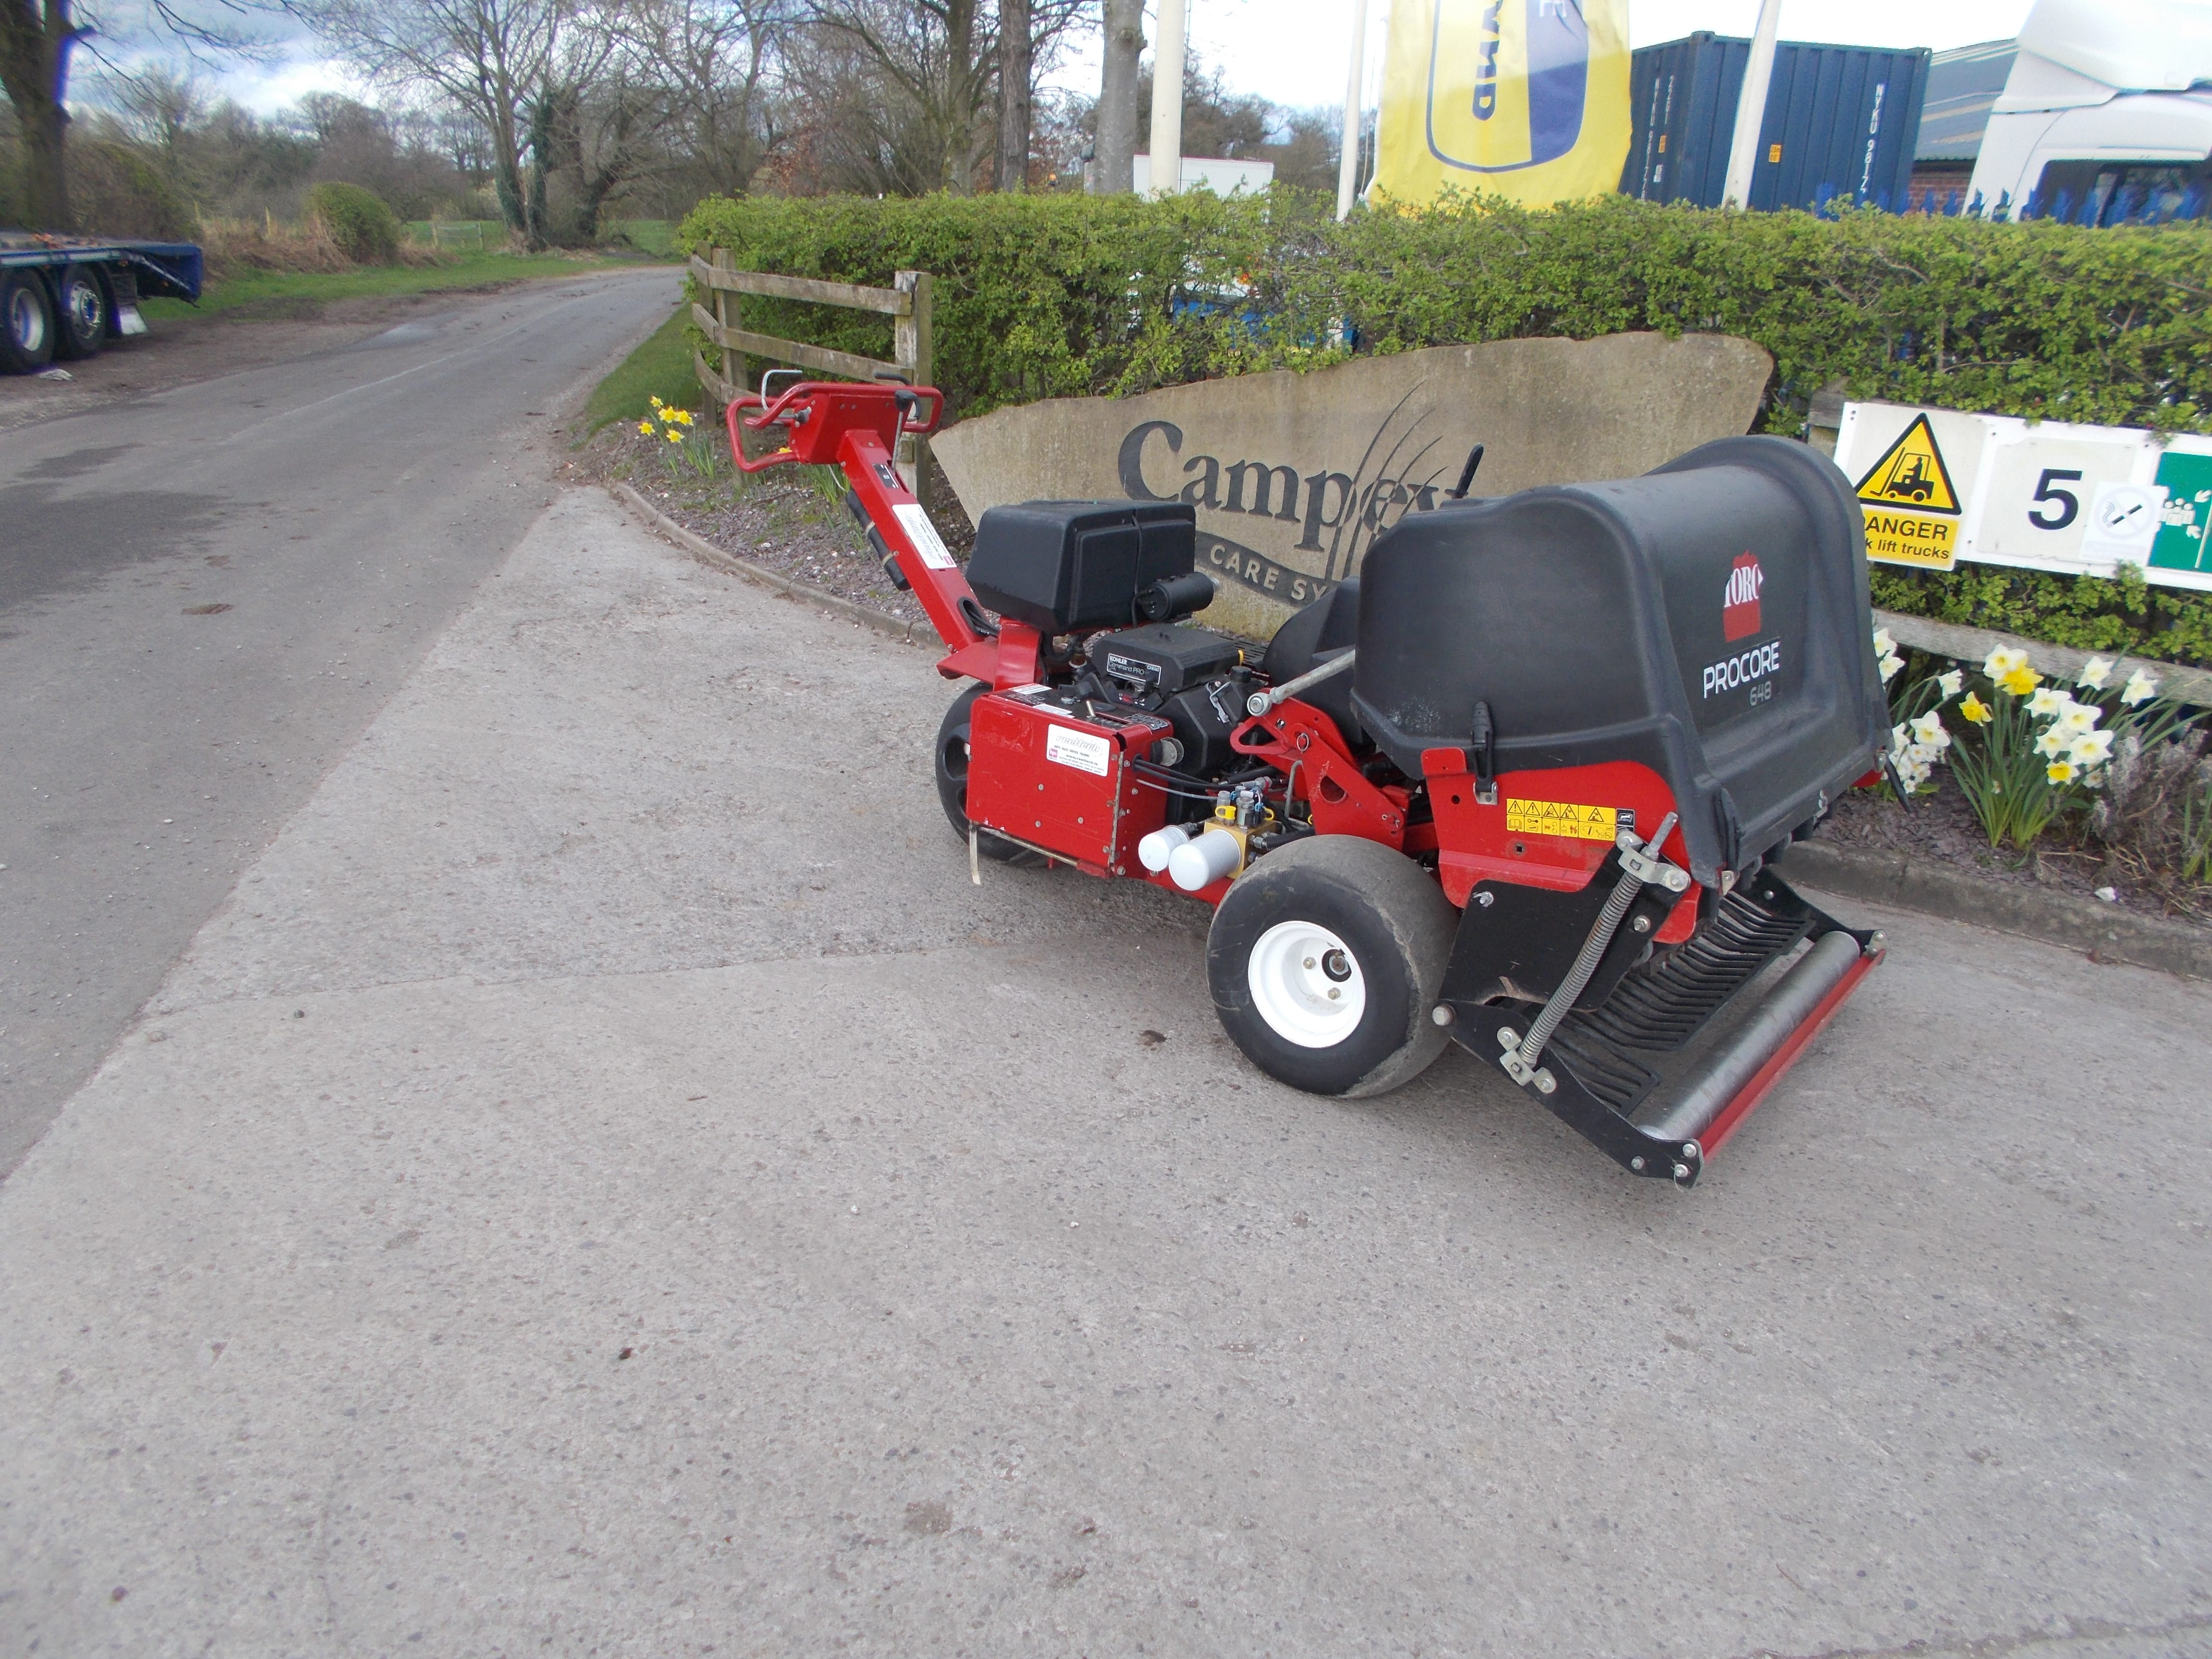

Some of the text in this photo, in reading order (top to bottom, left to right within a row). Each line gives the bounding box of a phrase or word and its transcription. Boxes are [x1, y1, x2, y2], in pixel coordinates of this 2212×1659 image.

[2028, 468, 2083, 530] 5
[1863, 516, 1948, 541] ANGER
[1877, 539, 1897, 553] lift
[1901, 542, 1949, 559] trucks
[1210, 544, 1280, 590] CARE
[1108, 661, 1144, 675] Command PRO
[1109, 655, 1128, 665] KOHLER
[1703, 641, 1780, 699] PROCORE
[1749, 680, 1772, 707] 648
